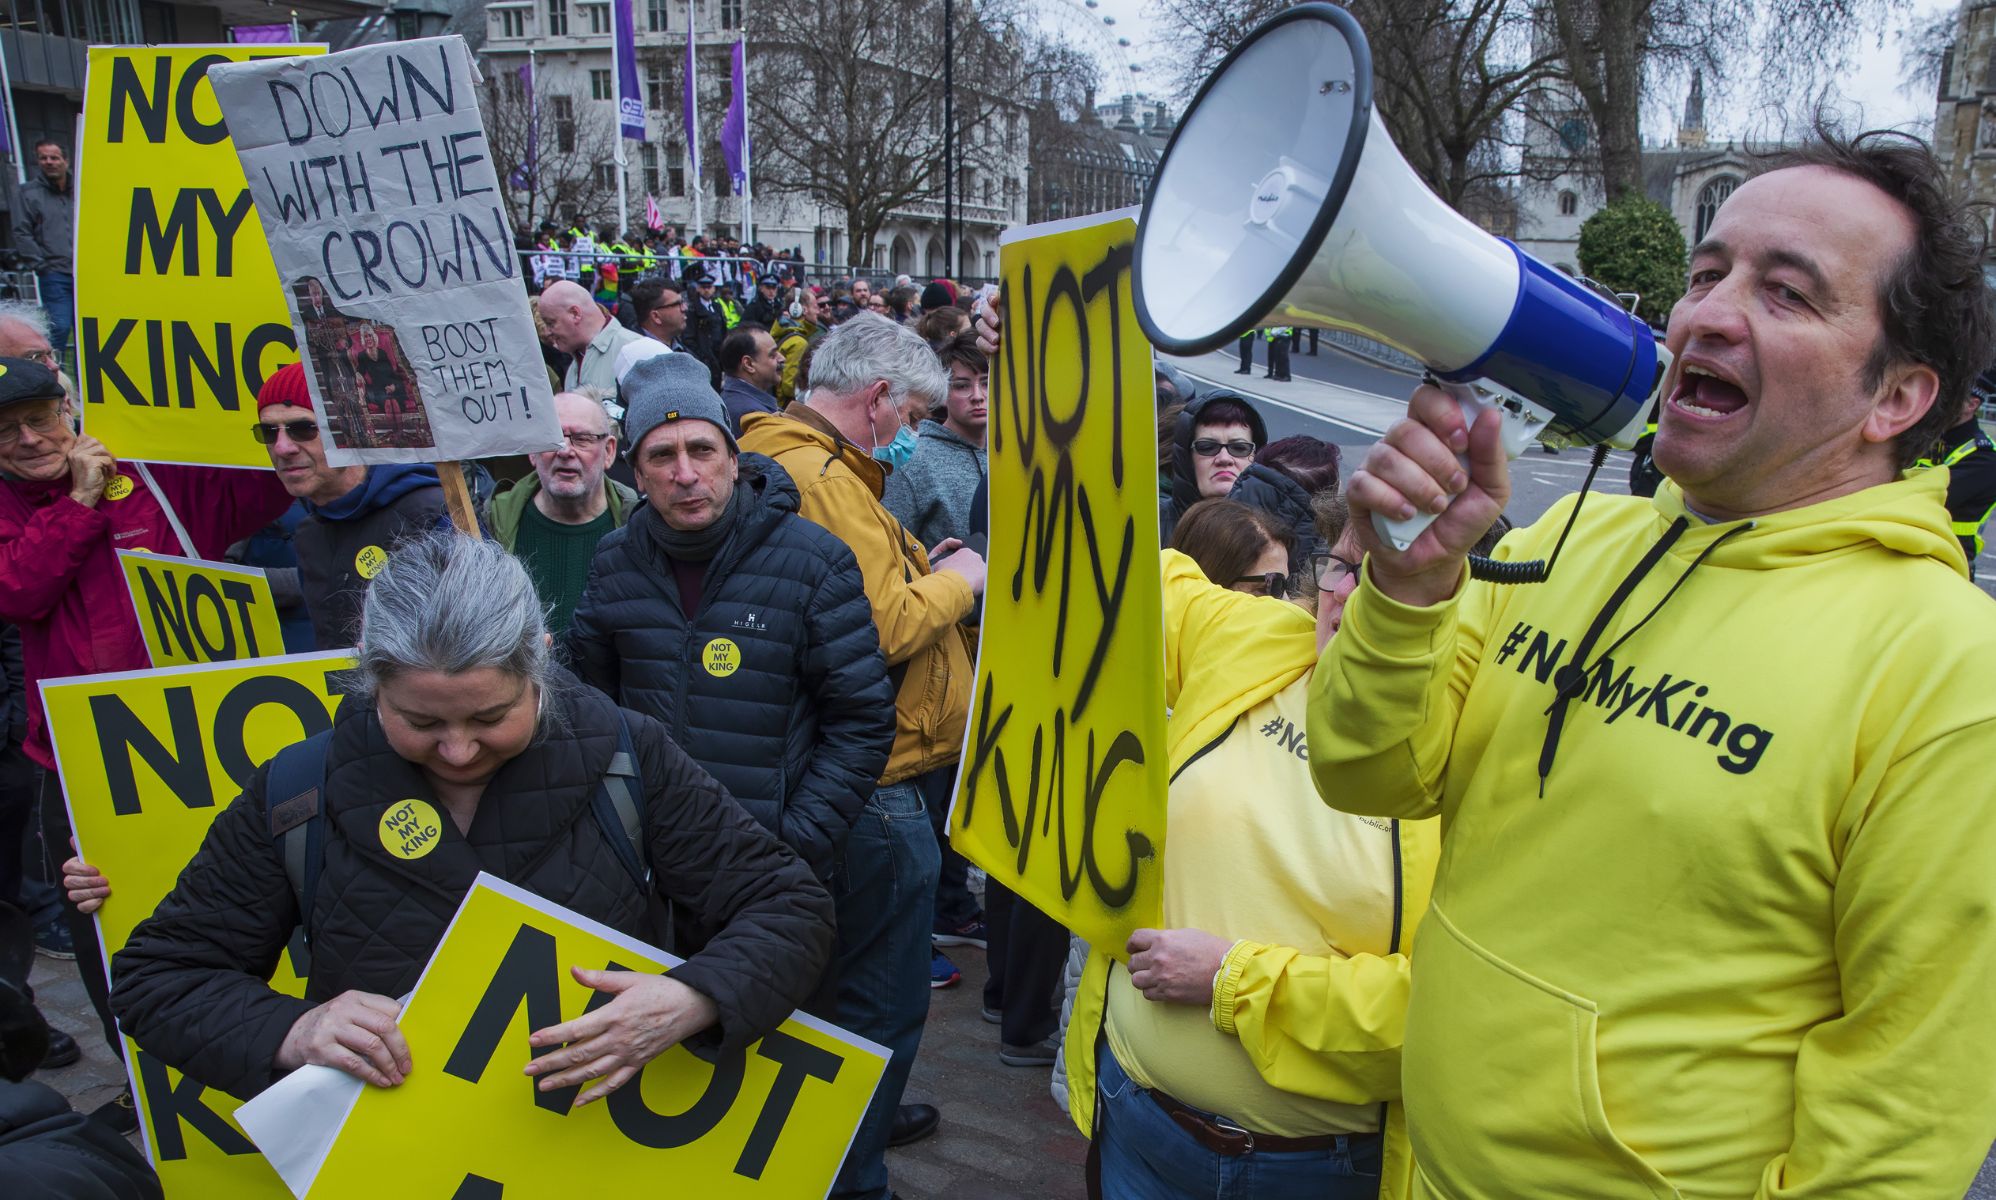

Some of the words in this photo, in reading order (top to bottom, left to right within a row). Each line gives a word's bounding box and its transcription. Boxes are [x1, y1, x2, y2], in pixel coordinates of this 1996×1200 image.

[267, 44, 455, 146] DOWN
[262, 151, 376, 225] WITH
[380, 130, 494, 206] THE
[125, 187, 254, 277] MY
[322, 207, 513, 301] CROWN
[422, 317, 498, 361] BOOT
[431, 360, 512, 393] THEM
[993, 240, 1136, 490] NOT
[109, 487, 130, 498] KING
[359, 547, 375, 564] NOT
[366, 556, 376, 568] MY
[1012, 448, 1135, 723] MY
[137, 566, 256, 662] NOT
[708, 662, 734, 671] KING
[711, 643, 732, 651] NOT
[713, 653, 729, 661] MY
[88, 668, 356, 816] NO
[962, 670, 1153, 907] KING
[385, 803, 415, 831] NOT
[398, 817, 420, 840] MY
[401, 825, 437, 856] KING
[443, 923, 845, 1181] NOT
